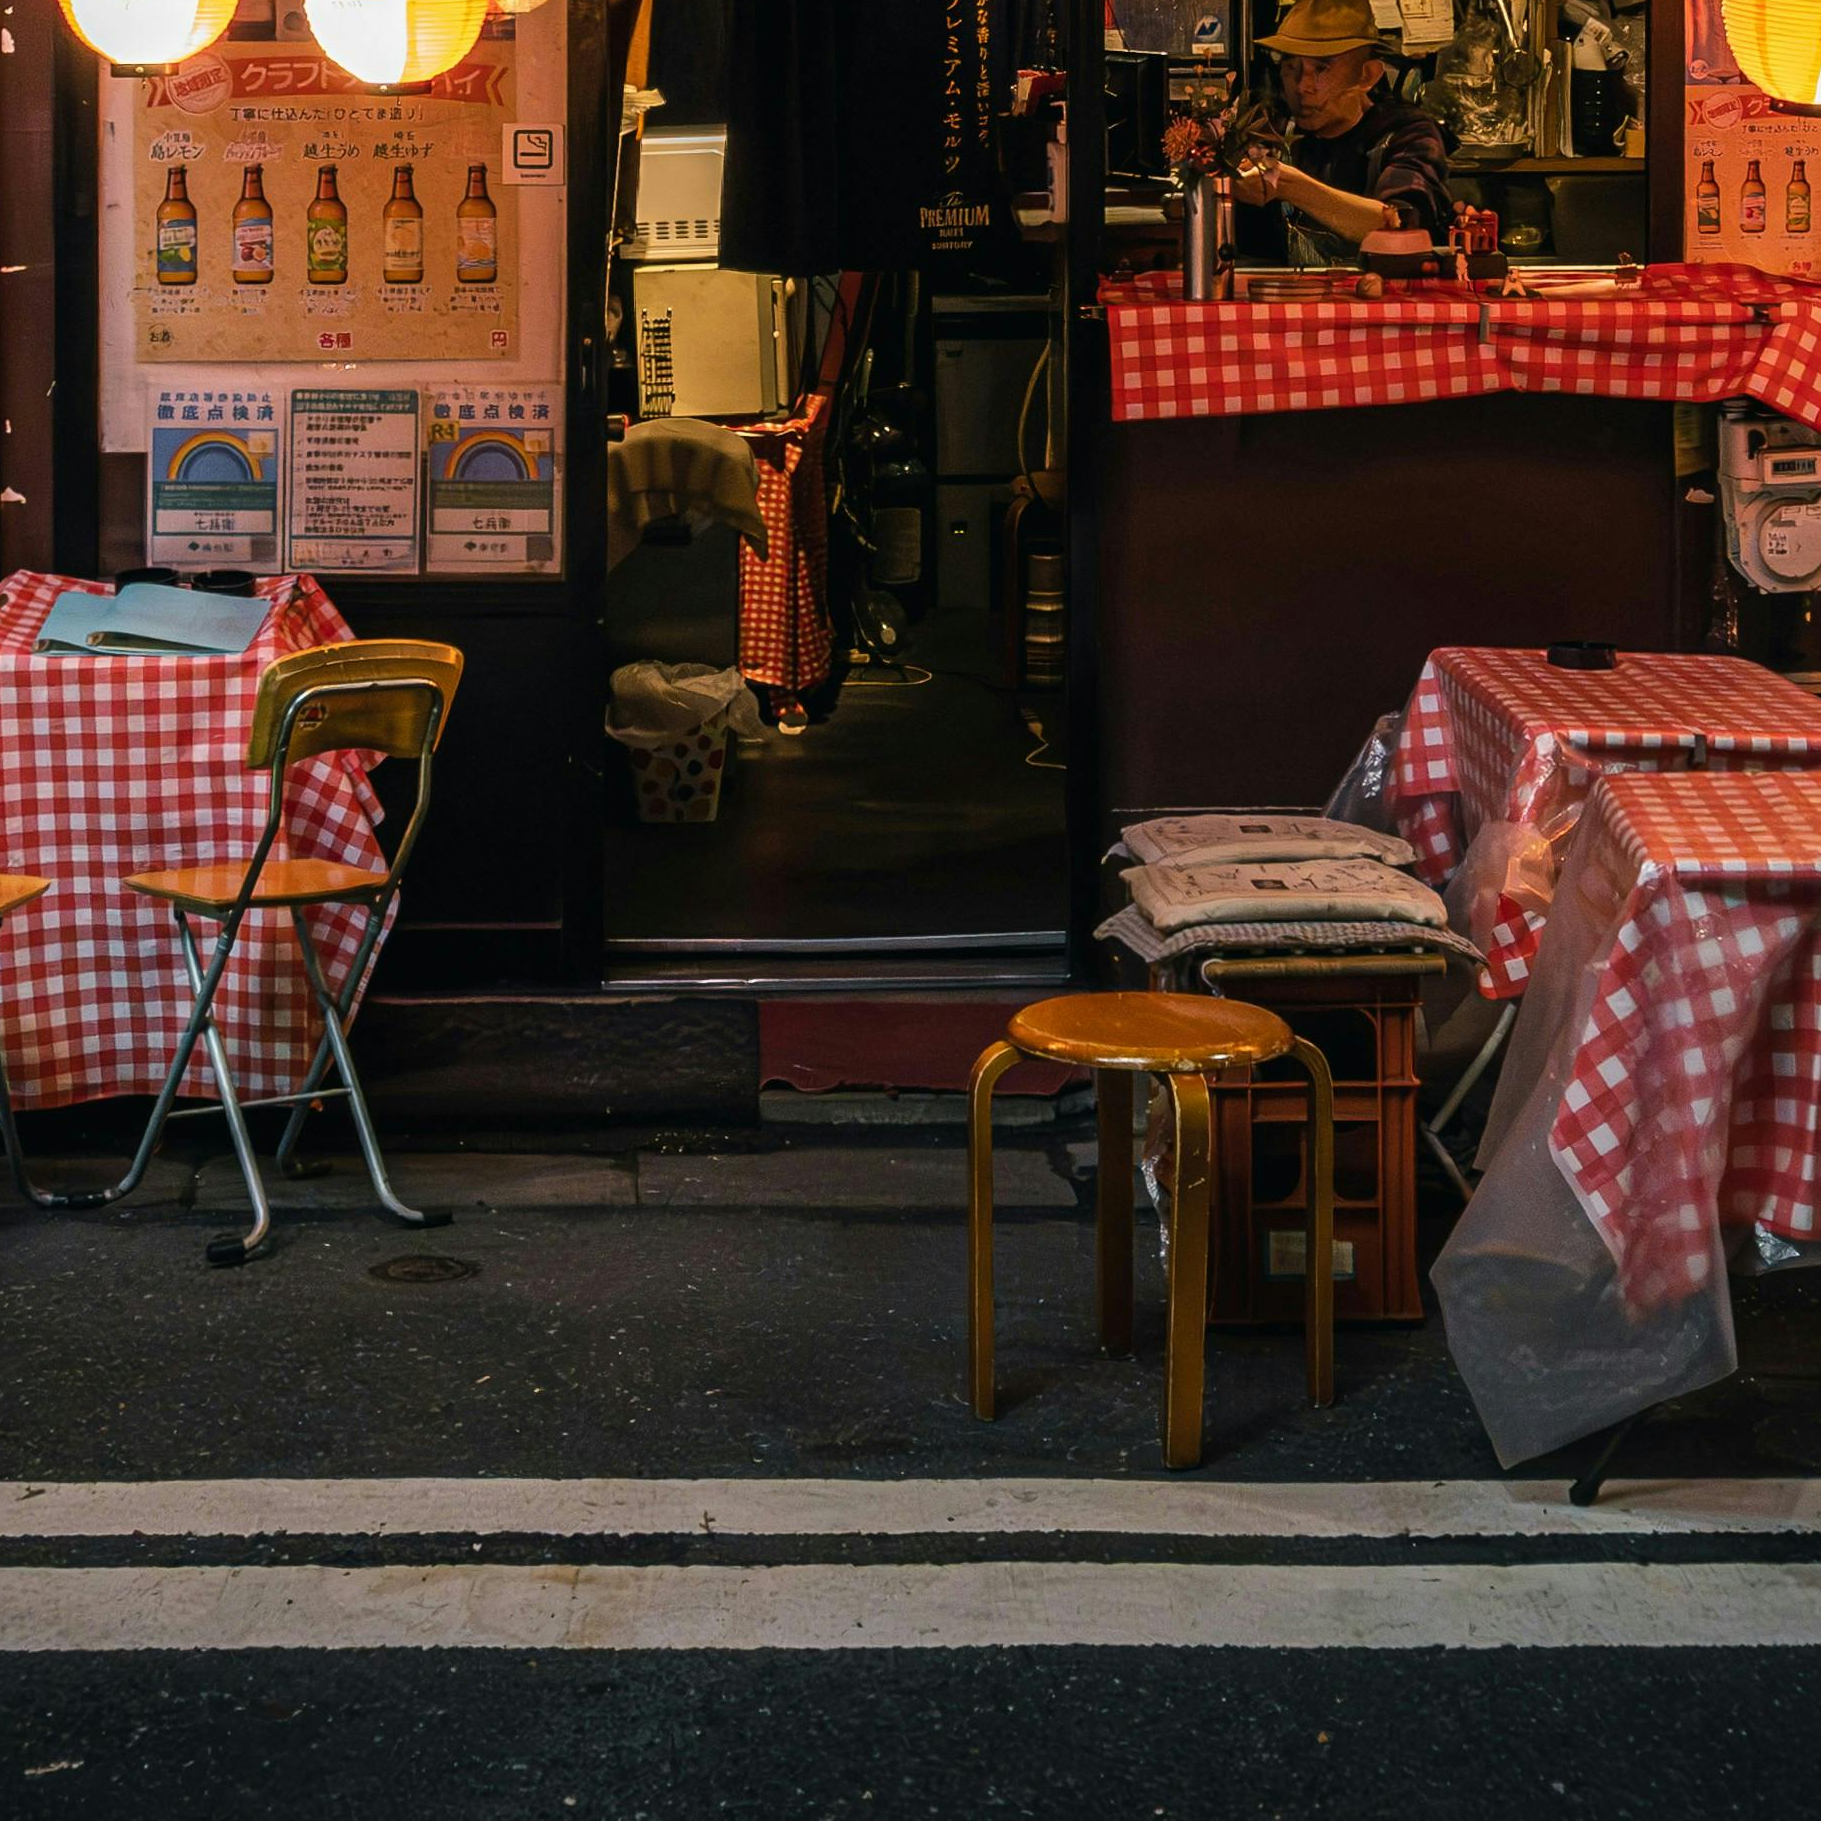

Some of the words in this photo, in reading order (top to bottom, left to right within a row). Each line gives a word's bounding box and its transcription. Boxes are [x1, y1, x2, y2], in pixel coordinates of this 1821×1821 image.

[151, 143, 204, 159] 島レモン
[919, 204, 990, 228] PREMIUM
[319, 332, 352, 349] 各種
[491, 331, 508, 348] 円
[432, 424, 454, 440] R4
